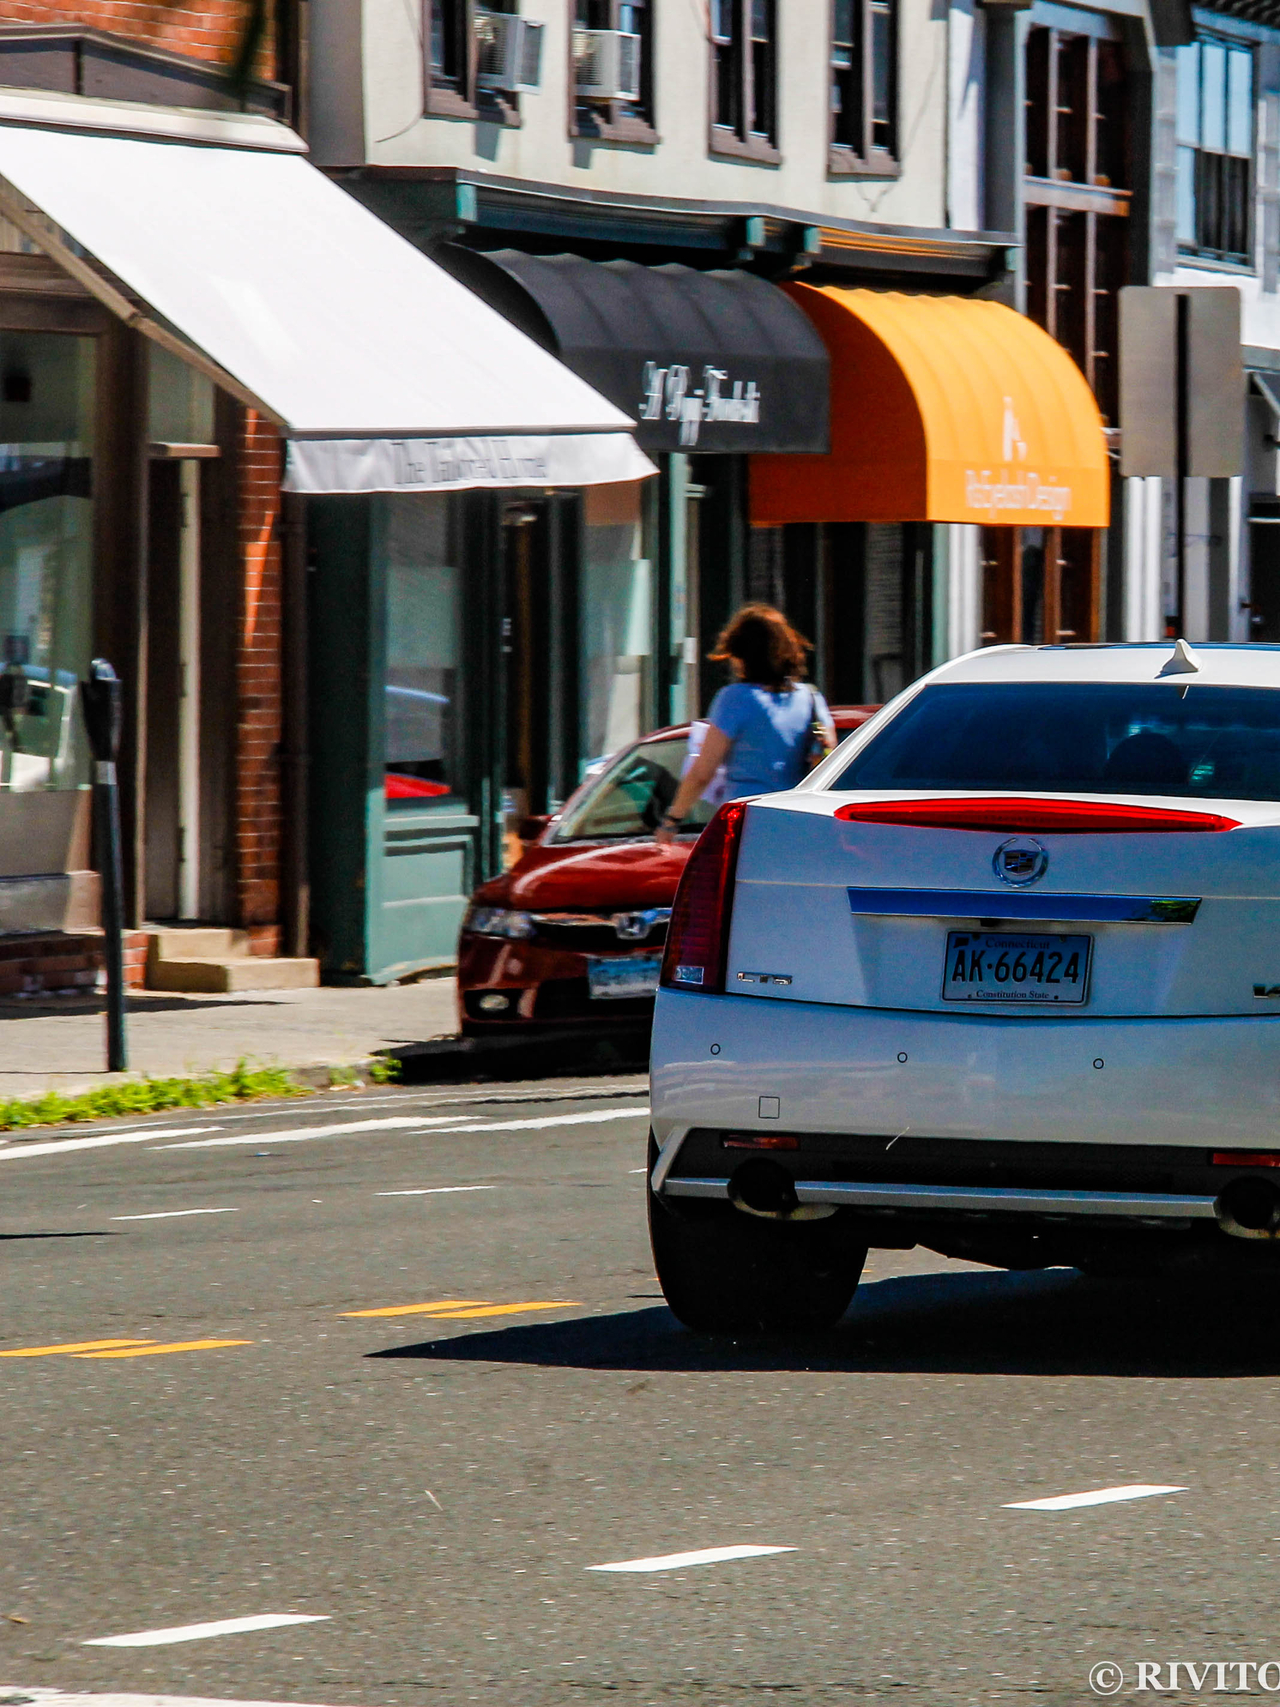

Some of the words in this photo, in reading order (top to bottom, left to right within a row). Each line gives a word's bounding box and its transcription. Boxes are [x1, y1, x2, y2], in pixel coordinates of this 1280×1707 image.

[391, 441, 425, 485] The
[985, 938, 1050, 950] Connecticut
[976, 989, 1028, 999] Constitution
[1029, 990, 1050, 999] State
